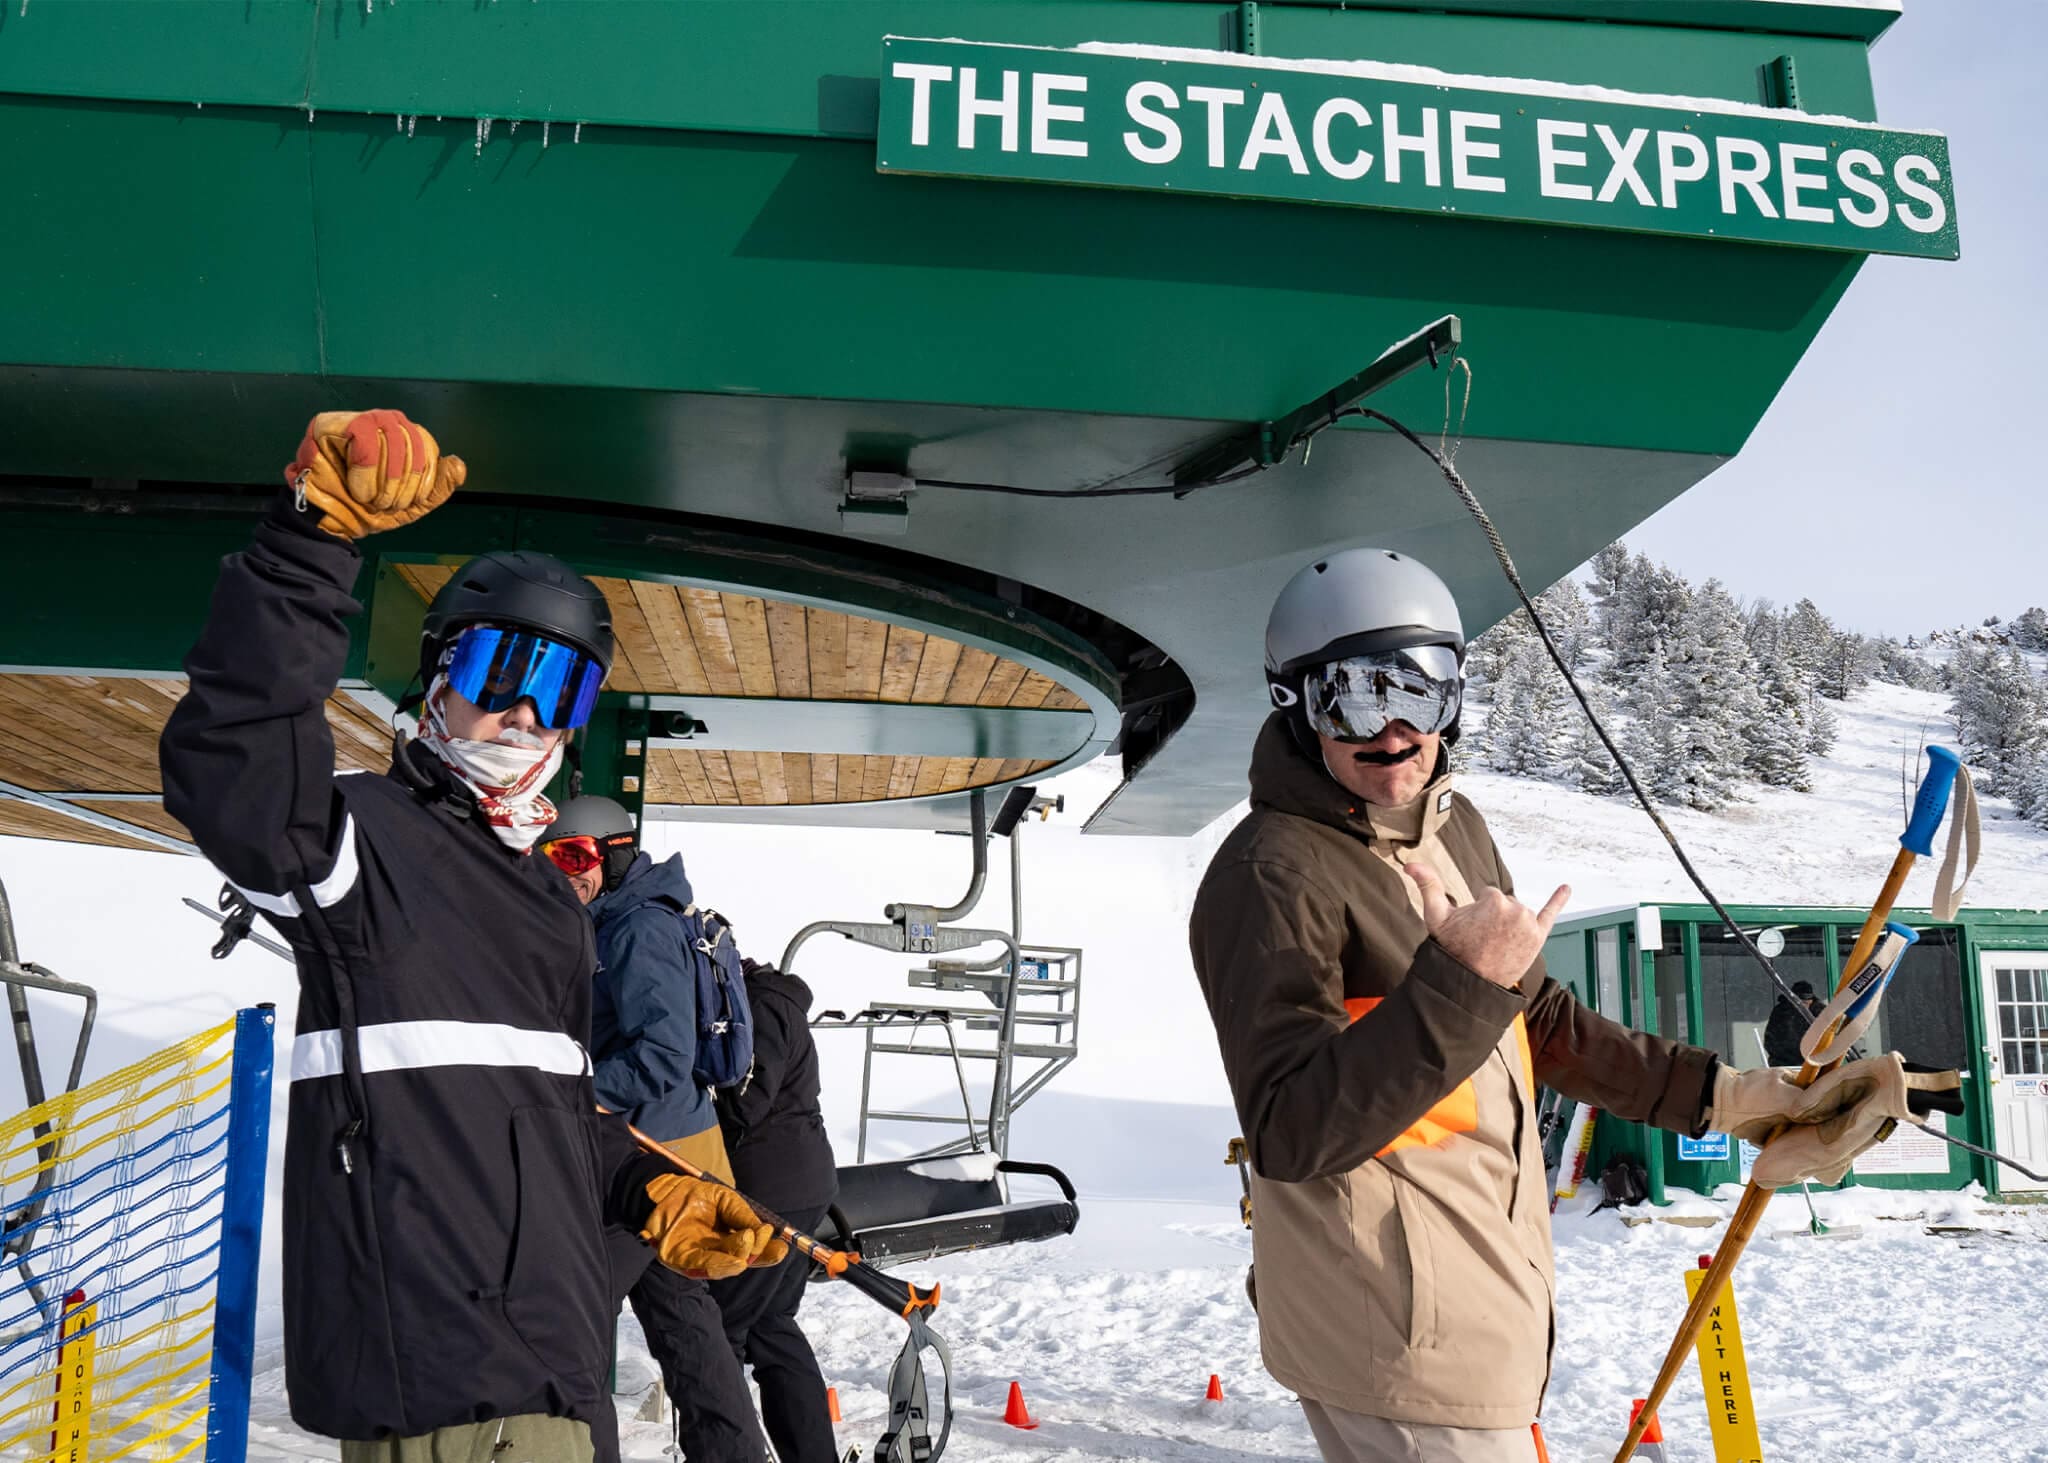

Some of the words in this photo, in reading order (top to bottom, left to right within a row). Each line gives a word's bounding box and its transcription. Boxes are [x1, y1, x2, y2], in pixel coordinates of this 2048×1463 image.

[892, 62, 1088, 157] THE
[1122, 81, 1506, 194] STACHE
[1536, 118, 1946, 234] EXPRESS
[1719, 1371, 1738, 1425] HERE
